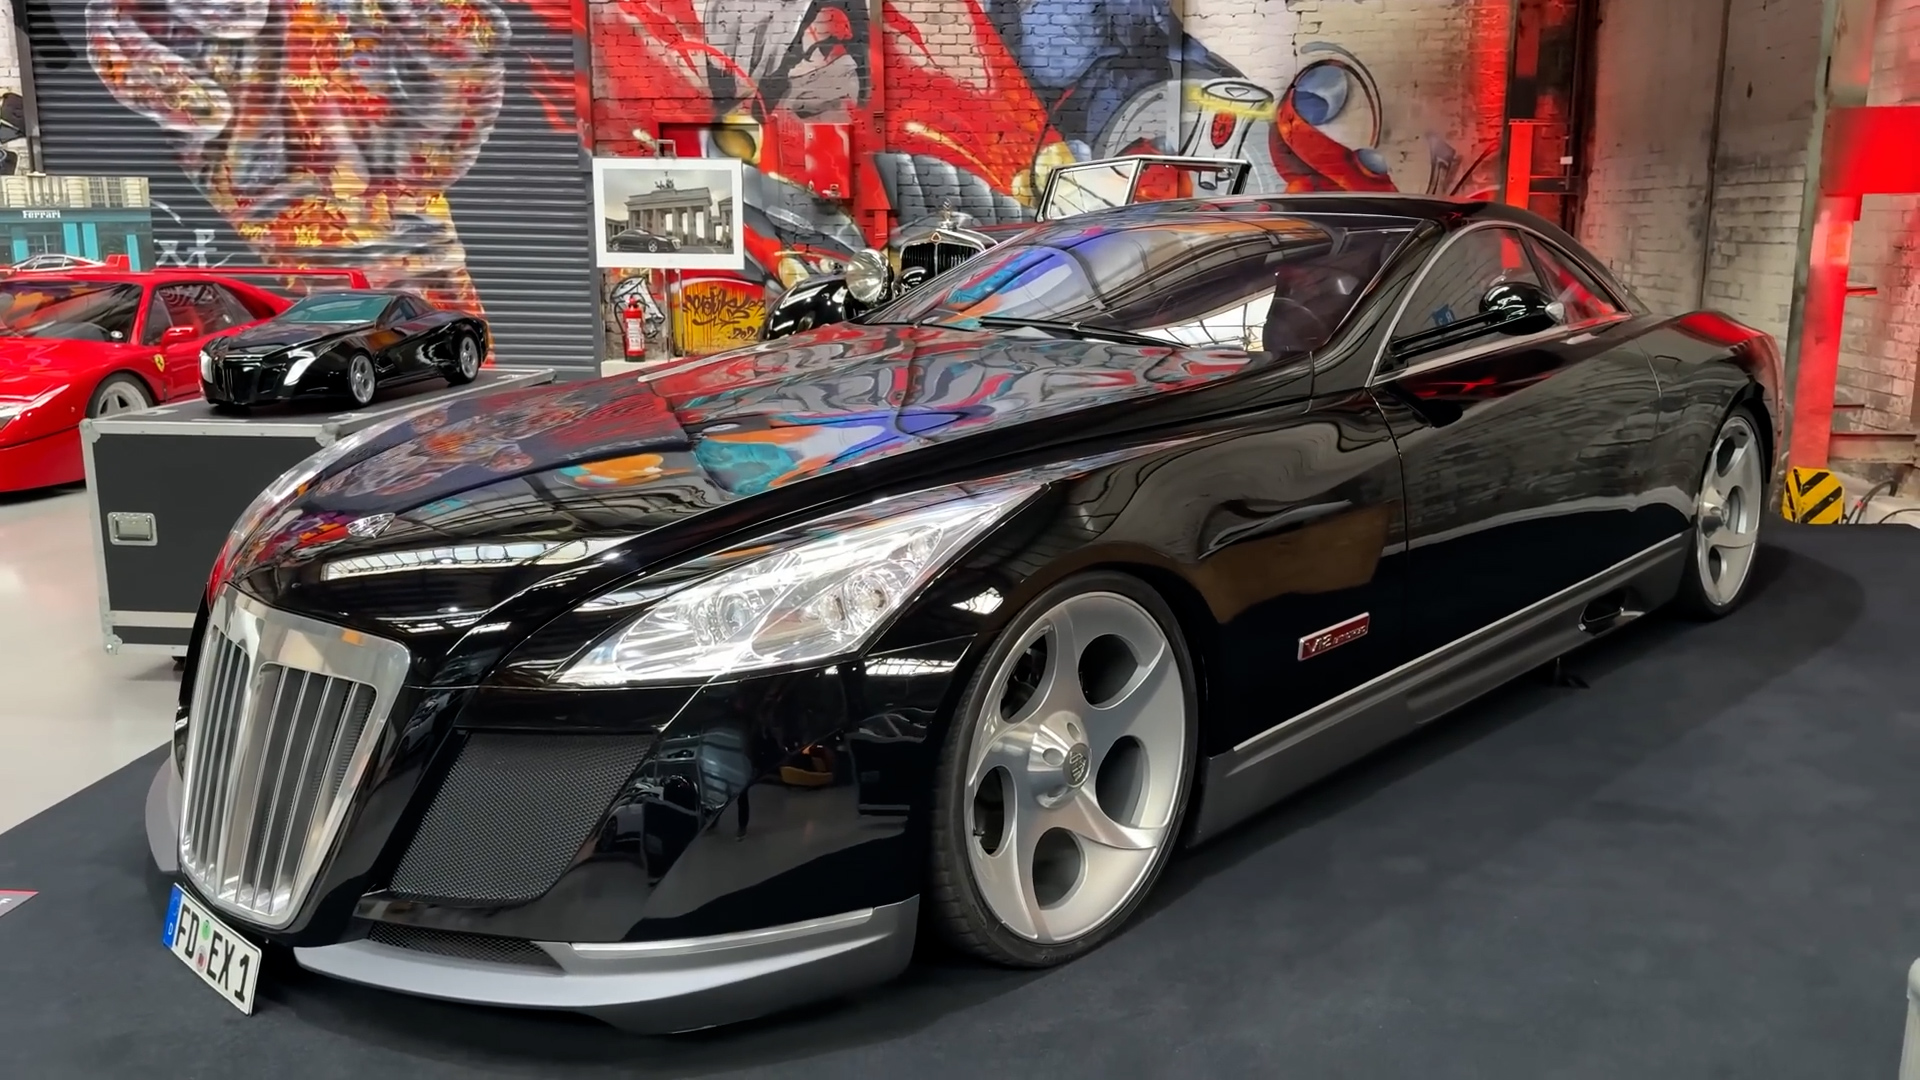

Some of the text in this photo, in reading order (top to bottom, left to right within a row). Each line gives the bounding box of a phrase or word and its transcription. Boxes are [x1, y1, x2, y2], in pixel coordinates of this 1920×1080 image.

[22, 210, 61, 219] Ferrari
[1304, 634, 1332, 653] V12
[168, 922, 174, 936] D
[175, 903, 250, 1003] FD EX 1
